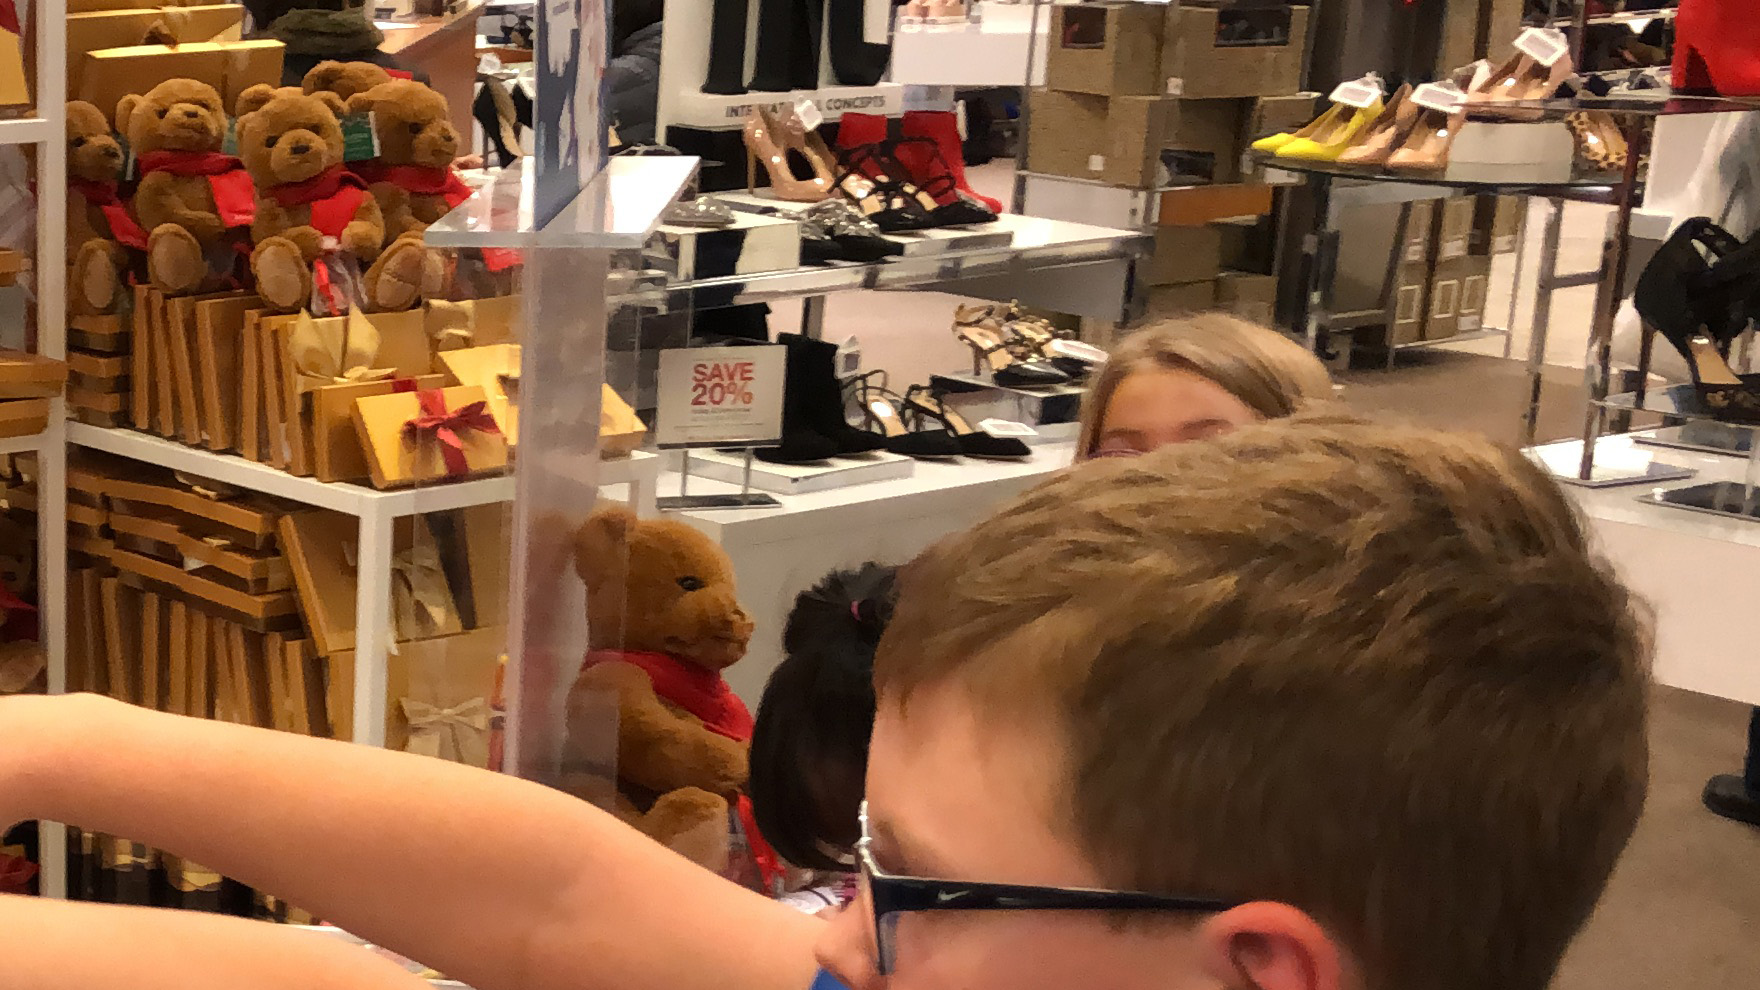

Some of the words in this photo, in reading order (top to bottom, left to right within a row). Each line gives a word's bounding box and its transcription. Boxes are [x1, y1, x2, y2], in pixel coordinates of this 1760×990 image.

[825, 95, 886, 111] CONCEPTS
[692, 362, 754, 382] SAVE
[691, 381, 753, 405] 20%
